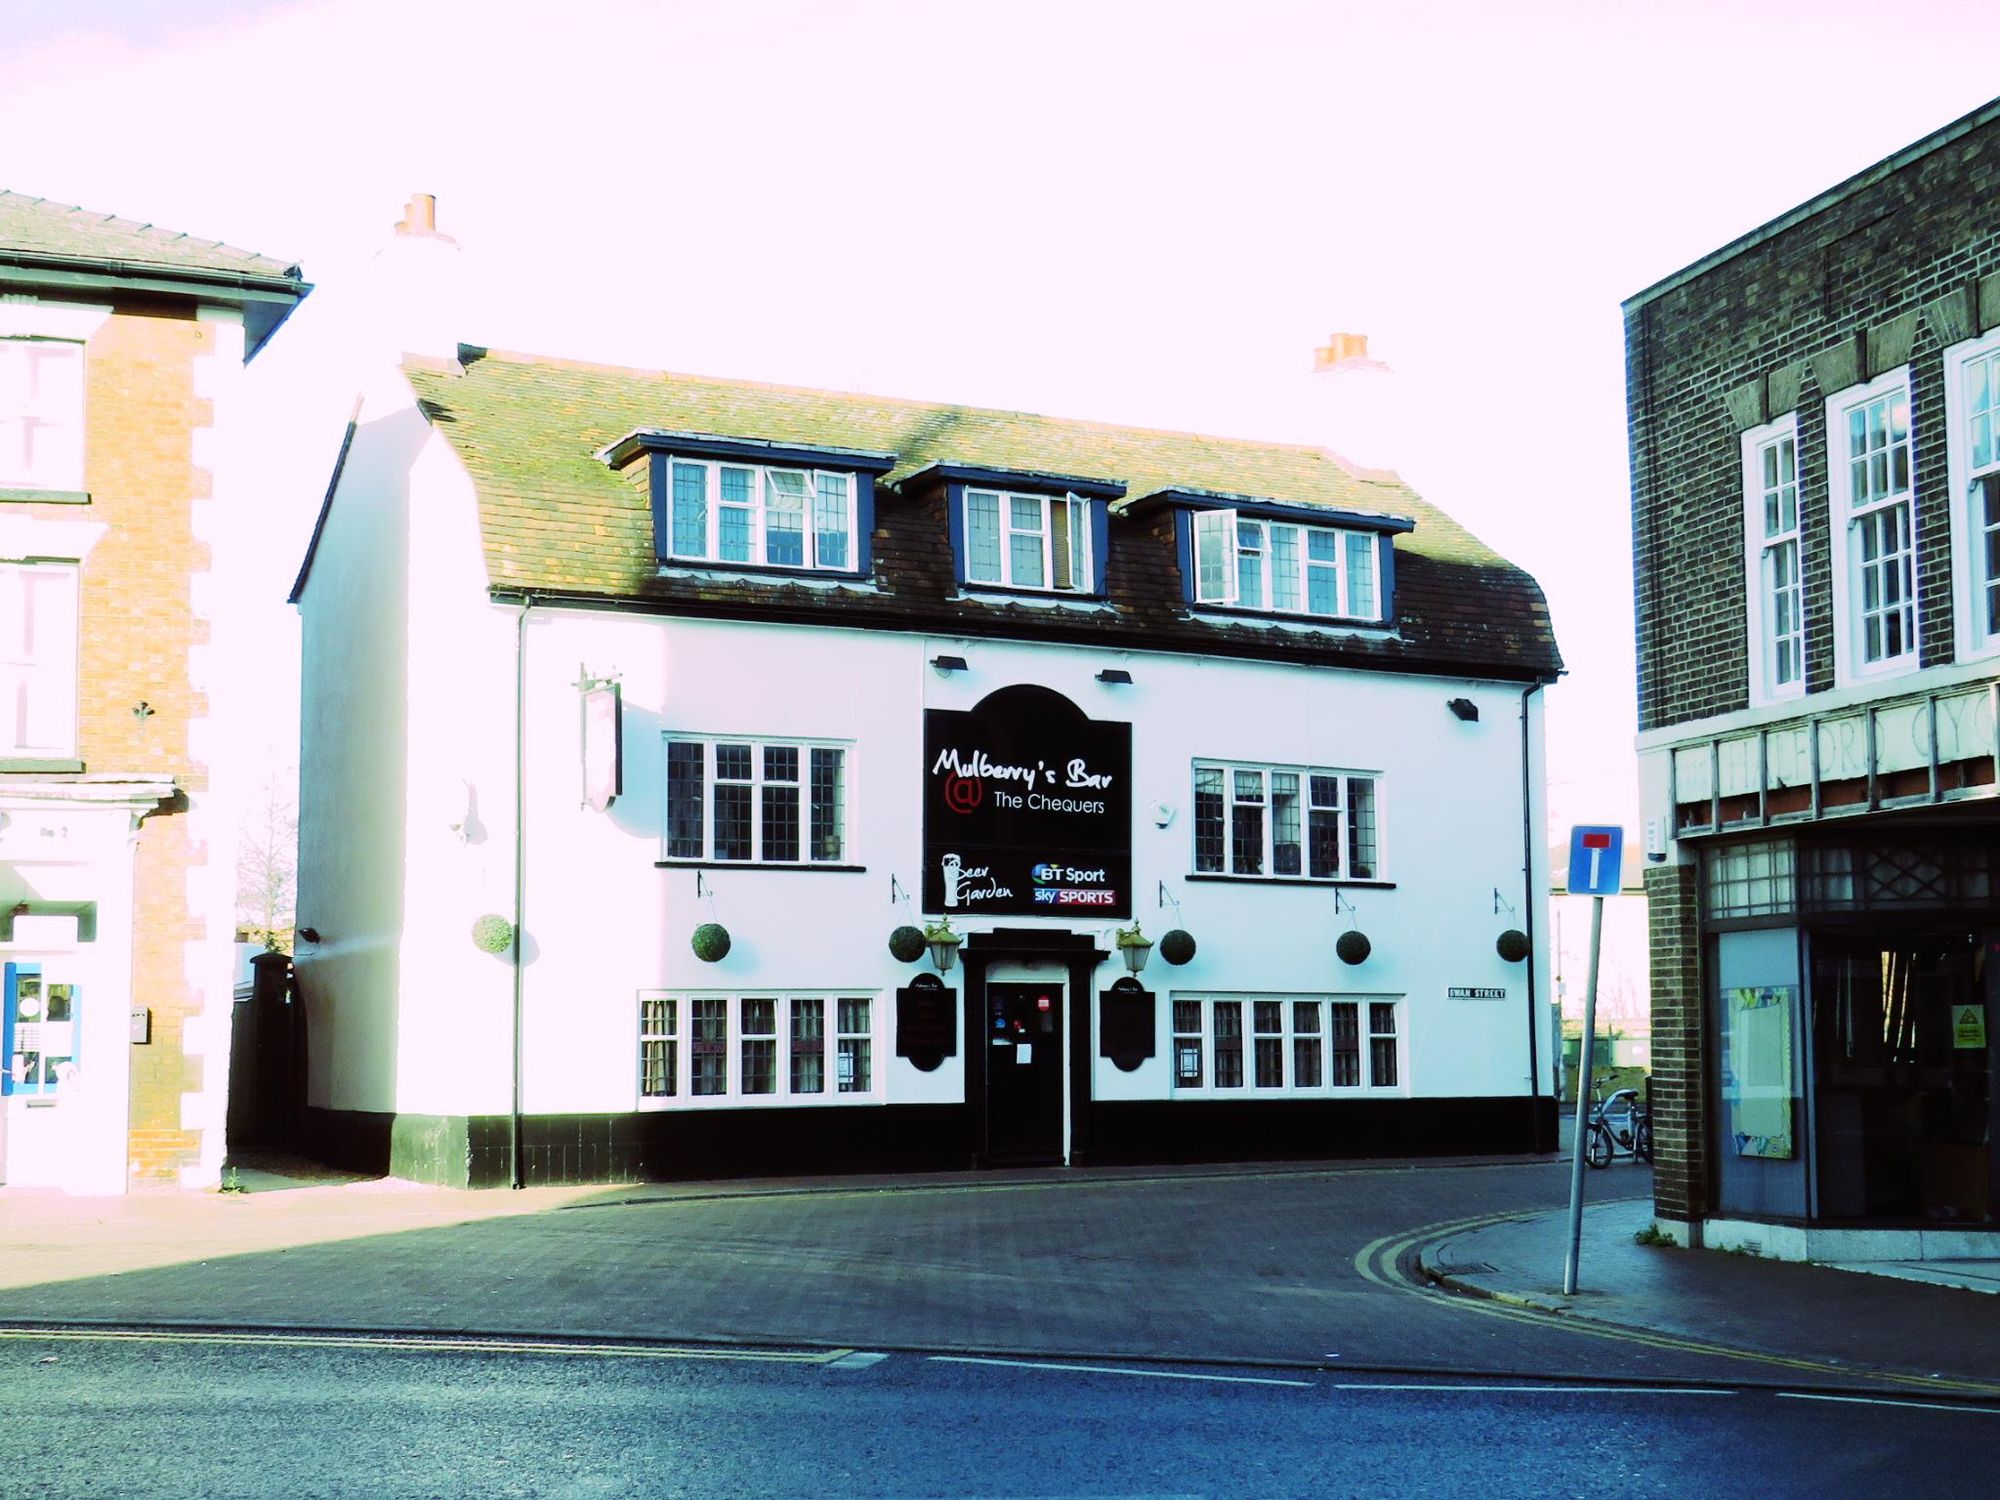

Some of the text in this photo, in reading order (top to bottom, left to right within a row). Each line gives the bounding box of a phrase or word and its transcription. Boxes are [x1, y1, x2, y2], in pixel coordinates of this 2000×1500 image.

[932, 748, 1113, 790] Mulberry's Bar
[944, 771, 983, 814] @
[994, 791, 1023, 809] The
[949, 859, 989, 880] Beer
[1041, 867, 1105, 884] BT Sport
[956, 877, 1013, 906] Garden
[1034, 889, 1113, 904] sky SPORTS
[1475, 989, 1505, 998] STREET
